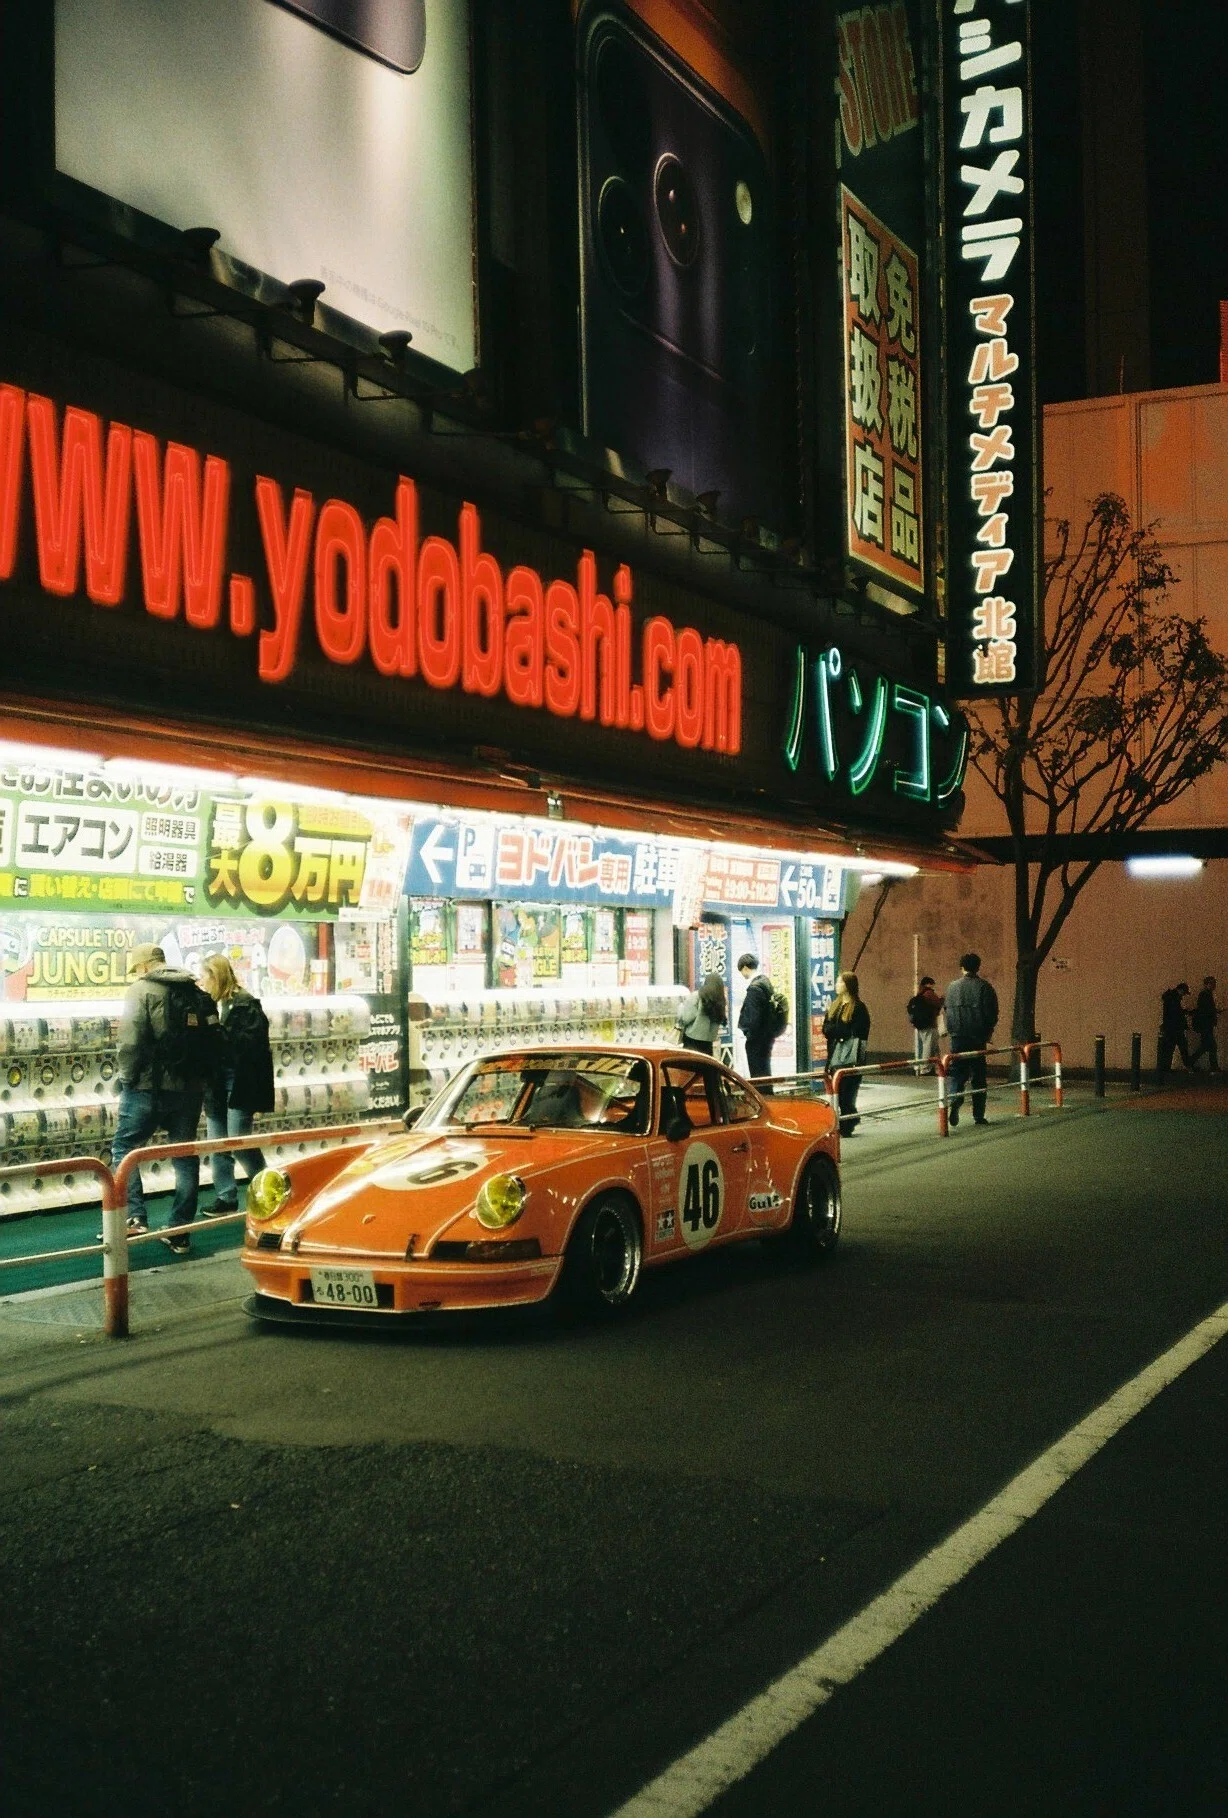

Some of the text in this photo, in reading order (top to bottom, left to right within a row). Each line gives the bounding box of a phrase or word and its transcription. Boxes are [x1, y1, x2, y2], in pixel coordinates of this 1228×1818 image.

[953, 0, 1024, 282] シカメラ
[848, 212, 885, 548] 取扱店
[886, 254, 919, 565] 免税品
[0, 382, 741, 757] ww.yodobashi.com
[968, 293, 1019, 684] マルチメディア北館
[786, 644, 970, 808] パソコン
[21, 814, 134, 861] エアコン
[464, 828, 476, 857] P
[37, 927, 135, 948] CAPSULE TOY
[683, 1159, 720, 1232] 46
[326, 1282, 374, 1304] 48-00
